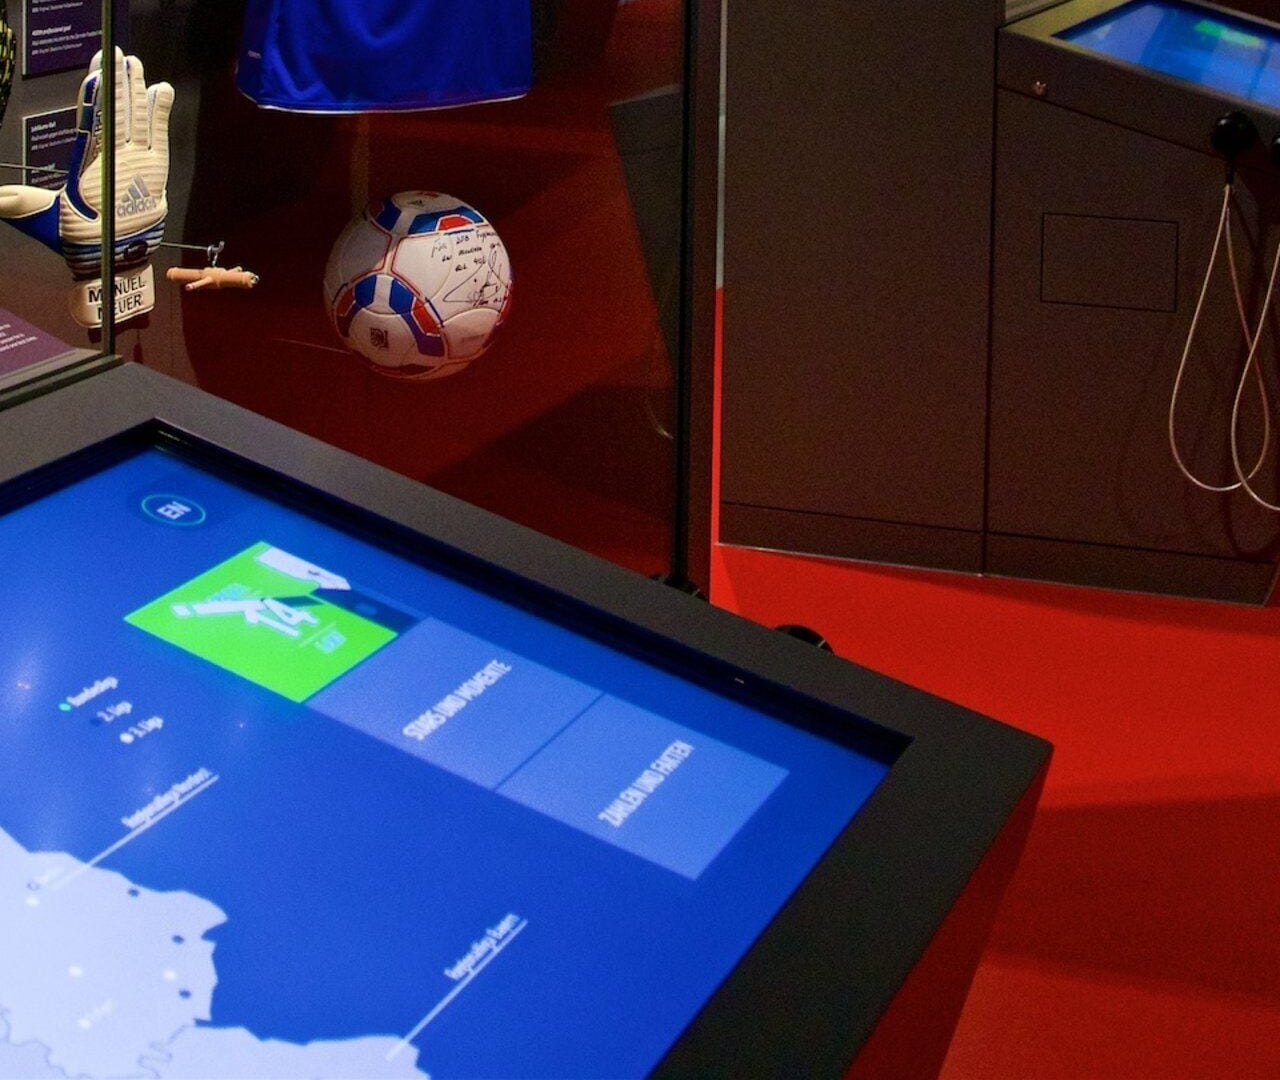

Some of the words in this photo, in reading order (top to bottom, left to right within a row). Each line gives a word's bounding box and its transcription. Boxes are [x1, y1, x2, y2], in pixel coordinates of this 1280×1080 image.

[88, 276, 145, 303] MNUEL
[156, 499, 193, 522] EN
[402, 710, 447, 741] STARS
[433, 694, 467, 719] UND
[455, 659, 512, 700] MOMENTE
[597, 786, 648, 828] ZAHLEN
[632, 768, 665, 794] UND
[650, 740, 695, 776] FAKTEN
